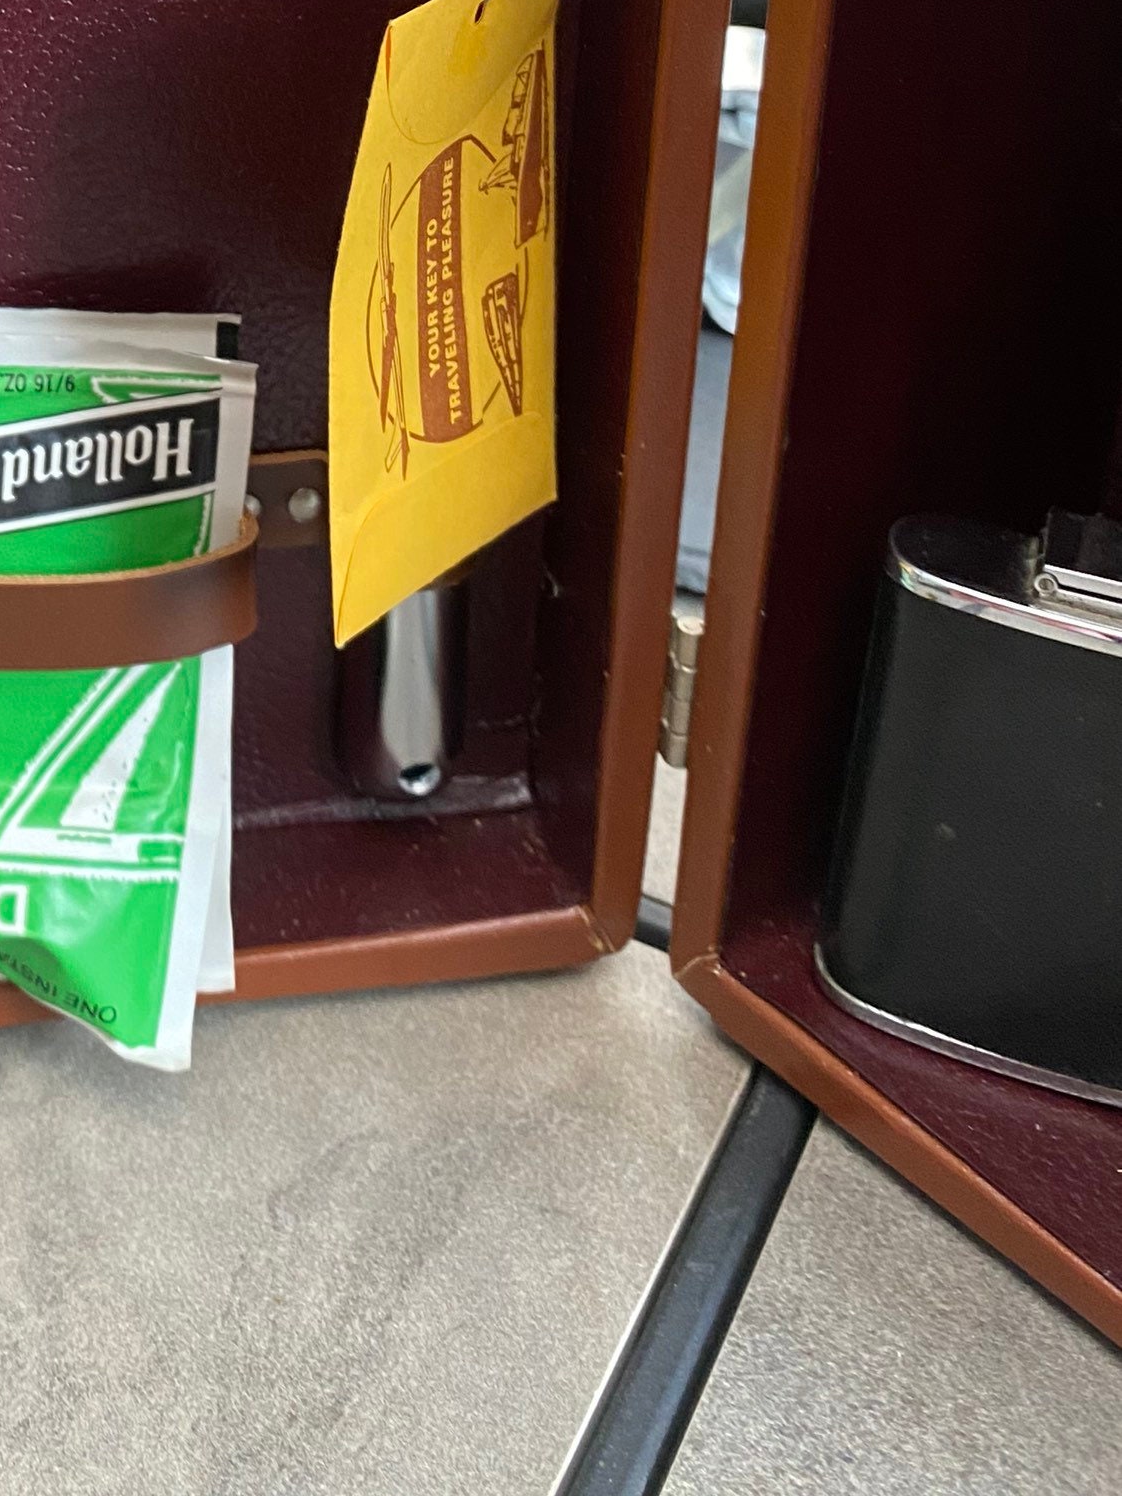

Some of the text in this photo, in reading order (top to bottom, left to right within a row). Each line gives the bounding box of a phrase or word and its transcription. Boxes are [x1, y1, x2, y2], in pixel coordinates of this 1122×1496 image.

[426, 217, 441, 379] YOUR KEY TO
[441, 156, 461, 425] TRAVELING PLEASURE
[0, 372, 27, 393] OZ.
[34, 372, 76, 393] 9/16
[0, 417, 196, 502] Holland
[64, 991, 117, 1024] ONE
